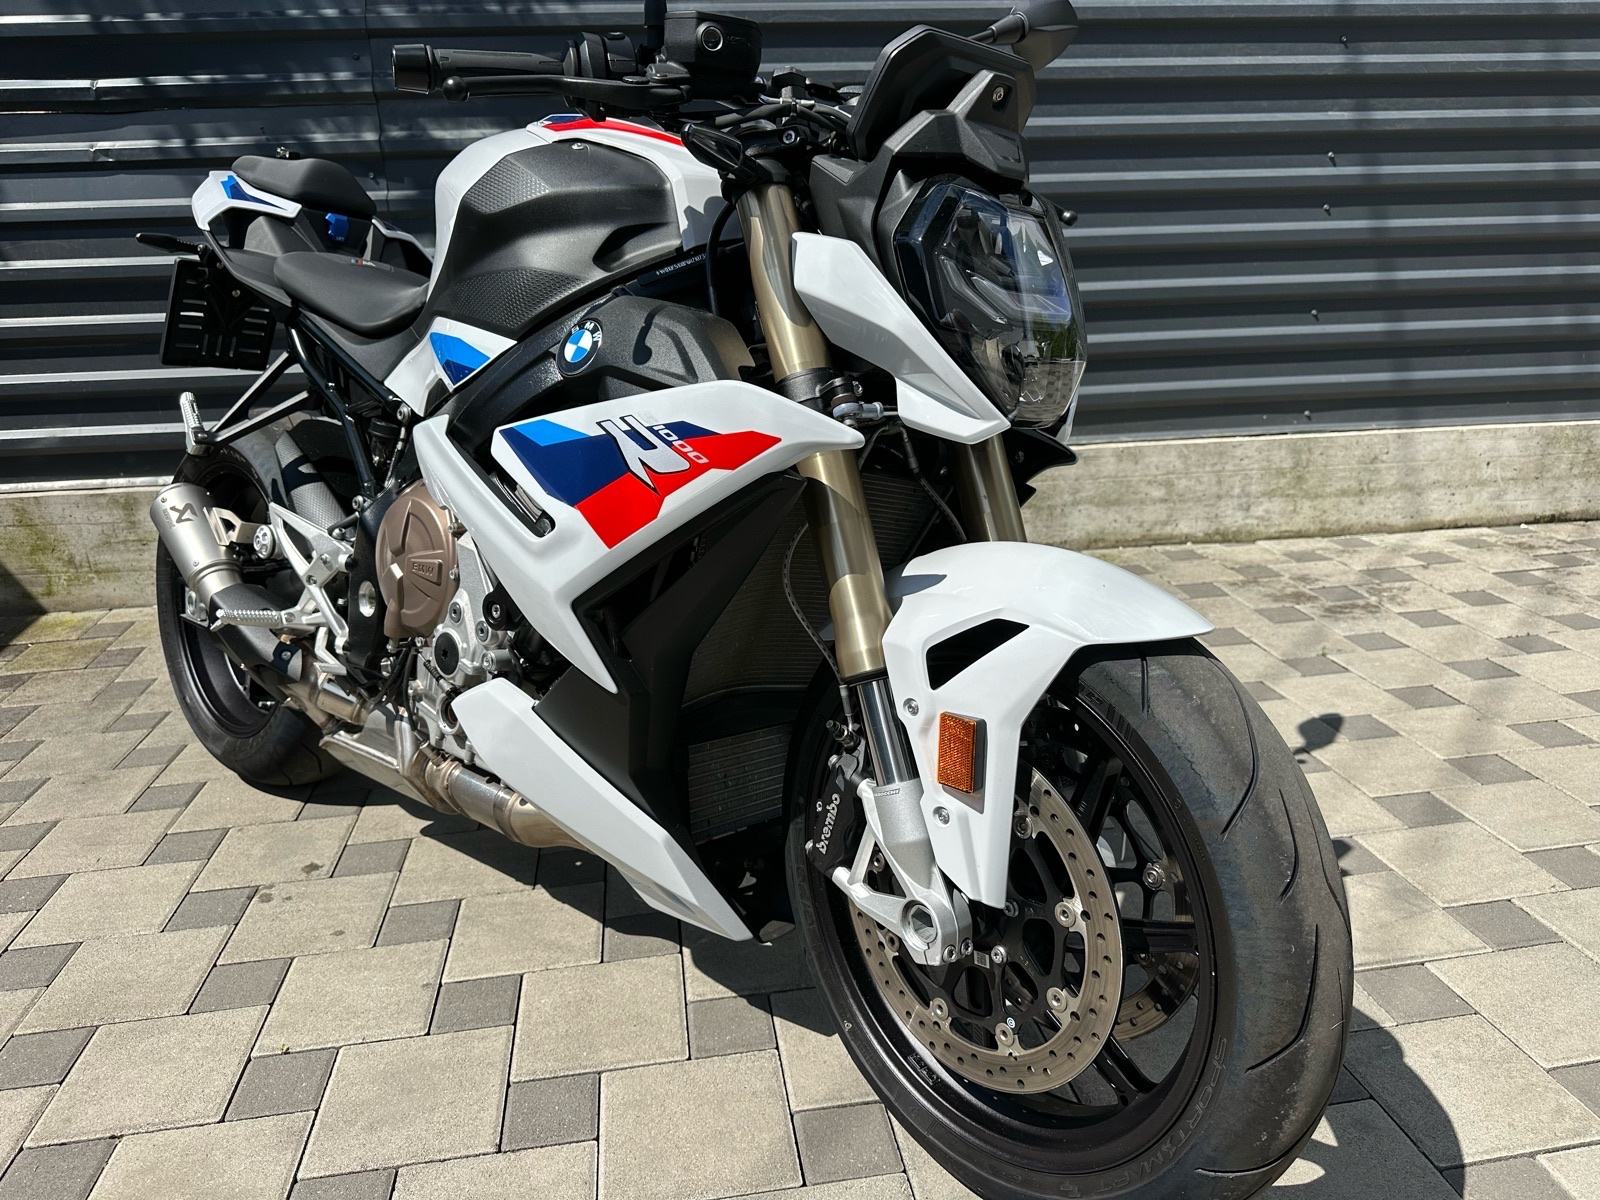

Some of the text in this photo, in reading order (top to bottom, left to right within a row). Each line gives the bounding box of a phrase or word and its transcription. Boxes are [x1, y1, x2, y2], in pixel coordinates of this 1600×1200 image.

[571, 321, 602, 341] BMW
[652, 424, 709, 464] 1000
[816, 793, 840, 855] brembo
